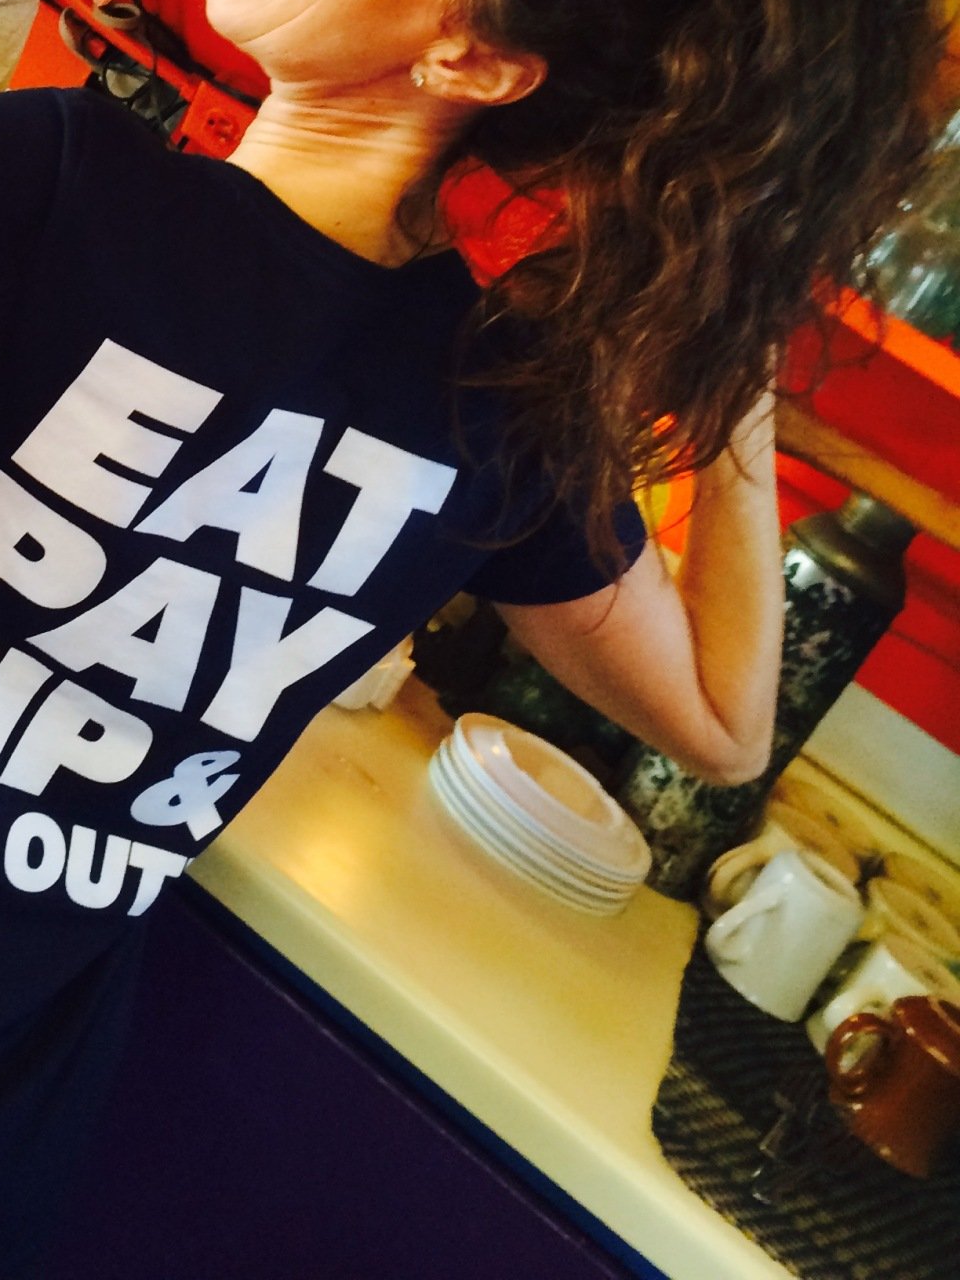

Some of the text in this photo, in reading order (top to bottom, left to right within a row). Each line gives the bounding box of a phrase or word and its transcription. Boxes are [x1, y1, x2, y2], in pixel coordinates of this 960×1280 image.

[10, 338, 458, 598] EAT
[130, 750, 241, 842] &
[3, 811, 193, 918] OUT
